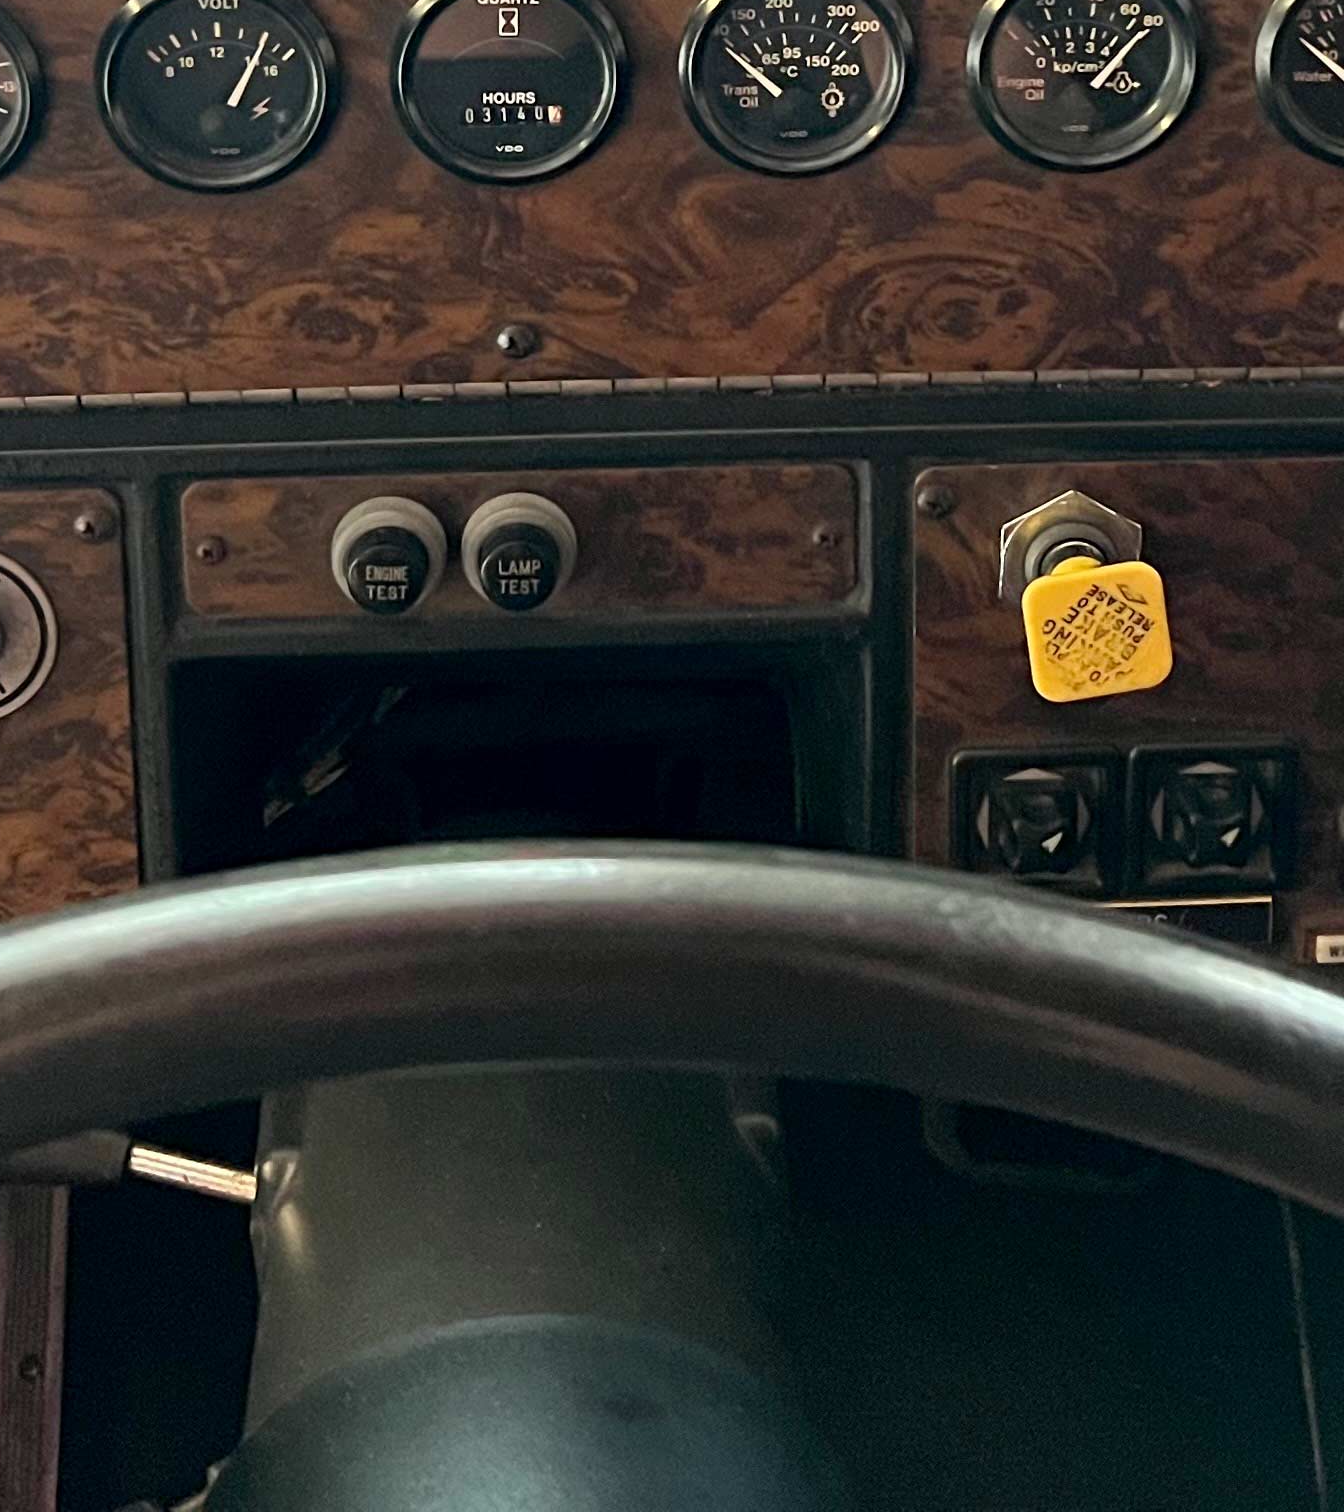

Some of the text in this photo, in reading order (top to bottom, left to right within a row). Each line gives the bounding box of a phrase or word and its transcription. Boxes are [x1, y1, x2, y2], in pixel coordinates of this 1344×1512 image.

[827, 4, 856, 17] 300
[1119, 4, 1141, 16] 60
[850, 19, 880, 33] 400
[1143, 15, 1164, 27] 80
[210, 46, 225, 59] 12
[783, 47, 801, 59] 95
[1066, 42, 1075, 54] 2
[1085, 42, 1095, 54] 3
[1101, 45, 1110, 58] 4
[179, 57, 194, 68] 10
[762, 53, 781, 65] 65
[805, 55, 830, 68] 150
[1036, 57, 1046, 69] 0
[166, 66, 175, 78] 8
[263, 65, 278, 77] 16
[831, 64, 860, 76] 200
[997, 76, 1045, 90] Engine
[721, 84, 758, 96] Trans
[1025, 89, 1044, 101] Oil
[482, 91, 536, 105] HOURS
[739, 96, 758, 108] Oil
[495, 145, 524, 153] VDO
[365, 565, 408, 582] ENGINE
[498, 559, 541, 576] LAMP
[365, 585, 408, 600] TEST
[498, 578, 541, 595] TEST
[1077, 597, 1098, 616] TO
[1086, 584, 1155, 631] RELEASE
